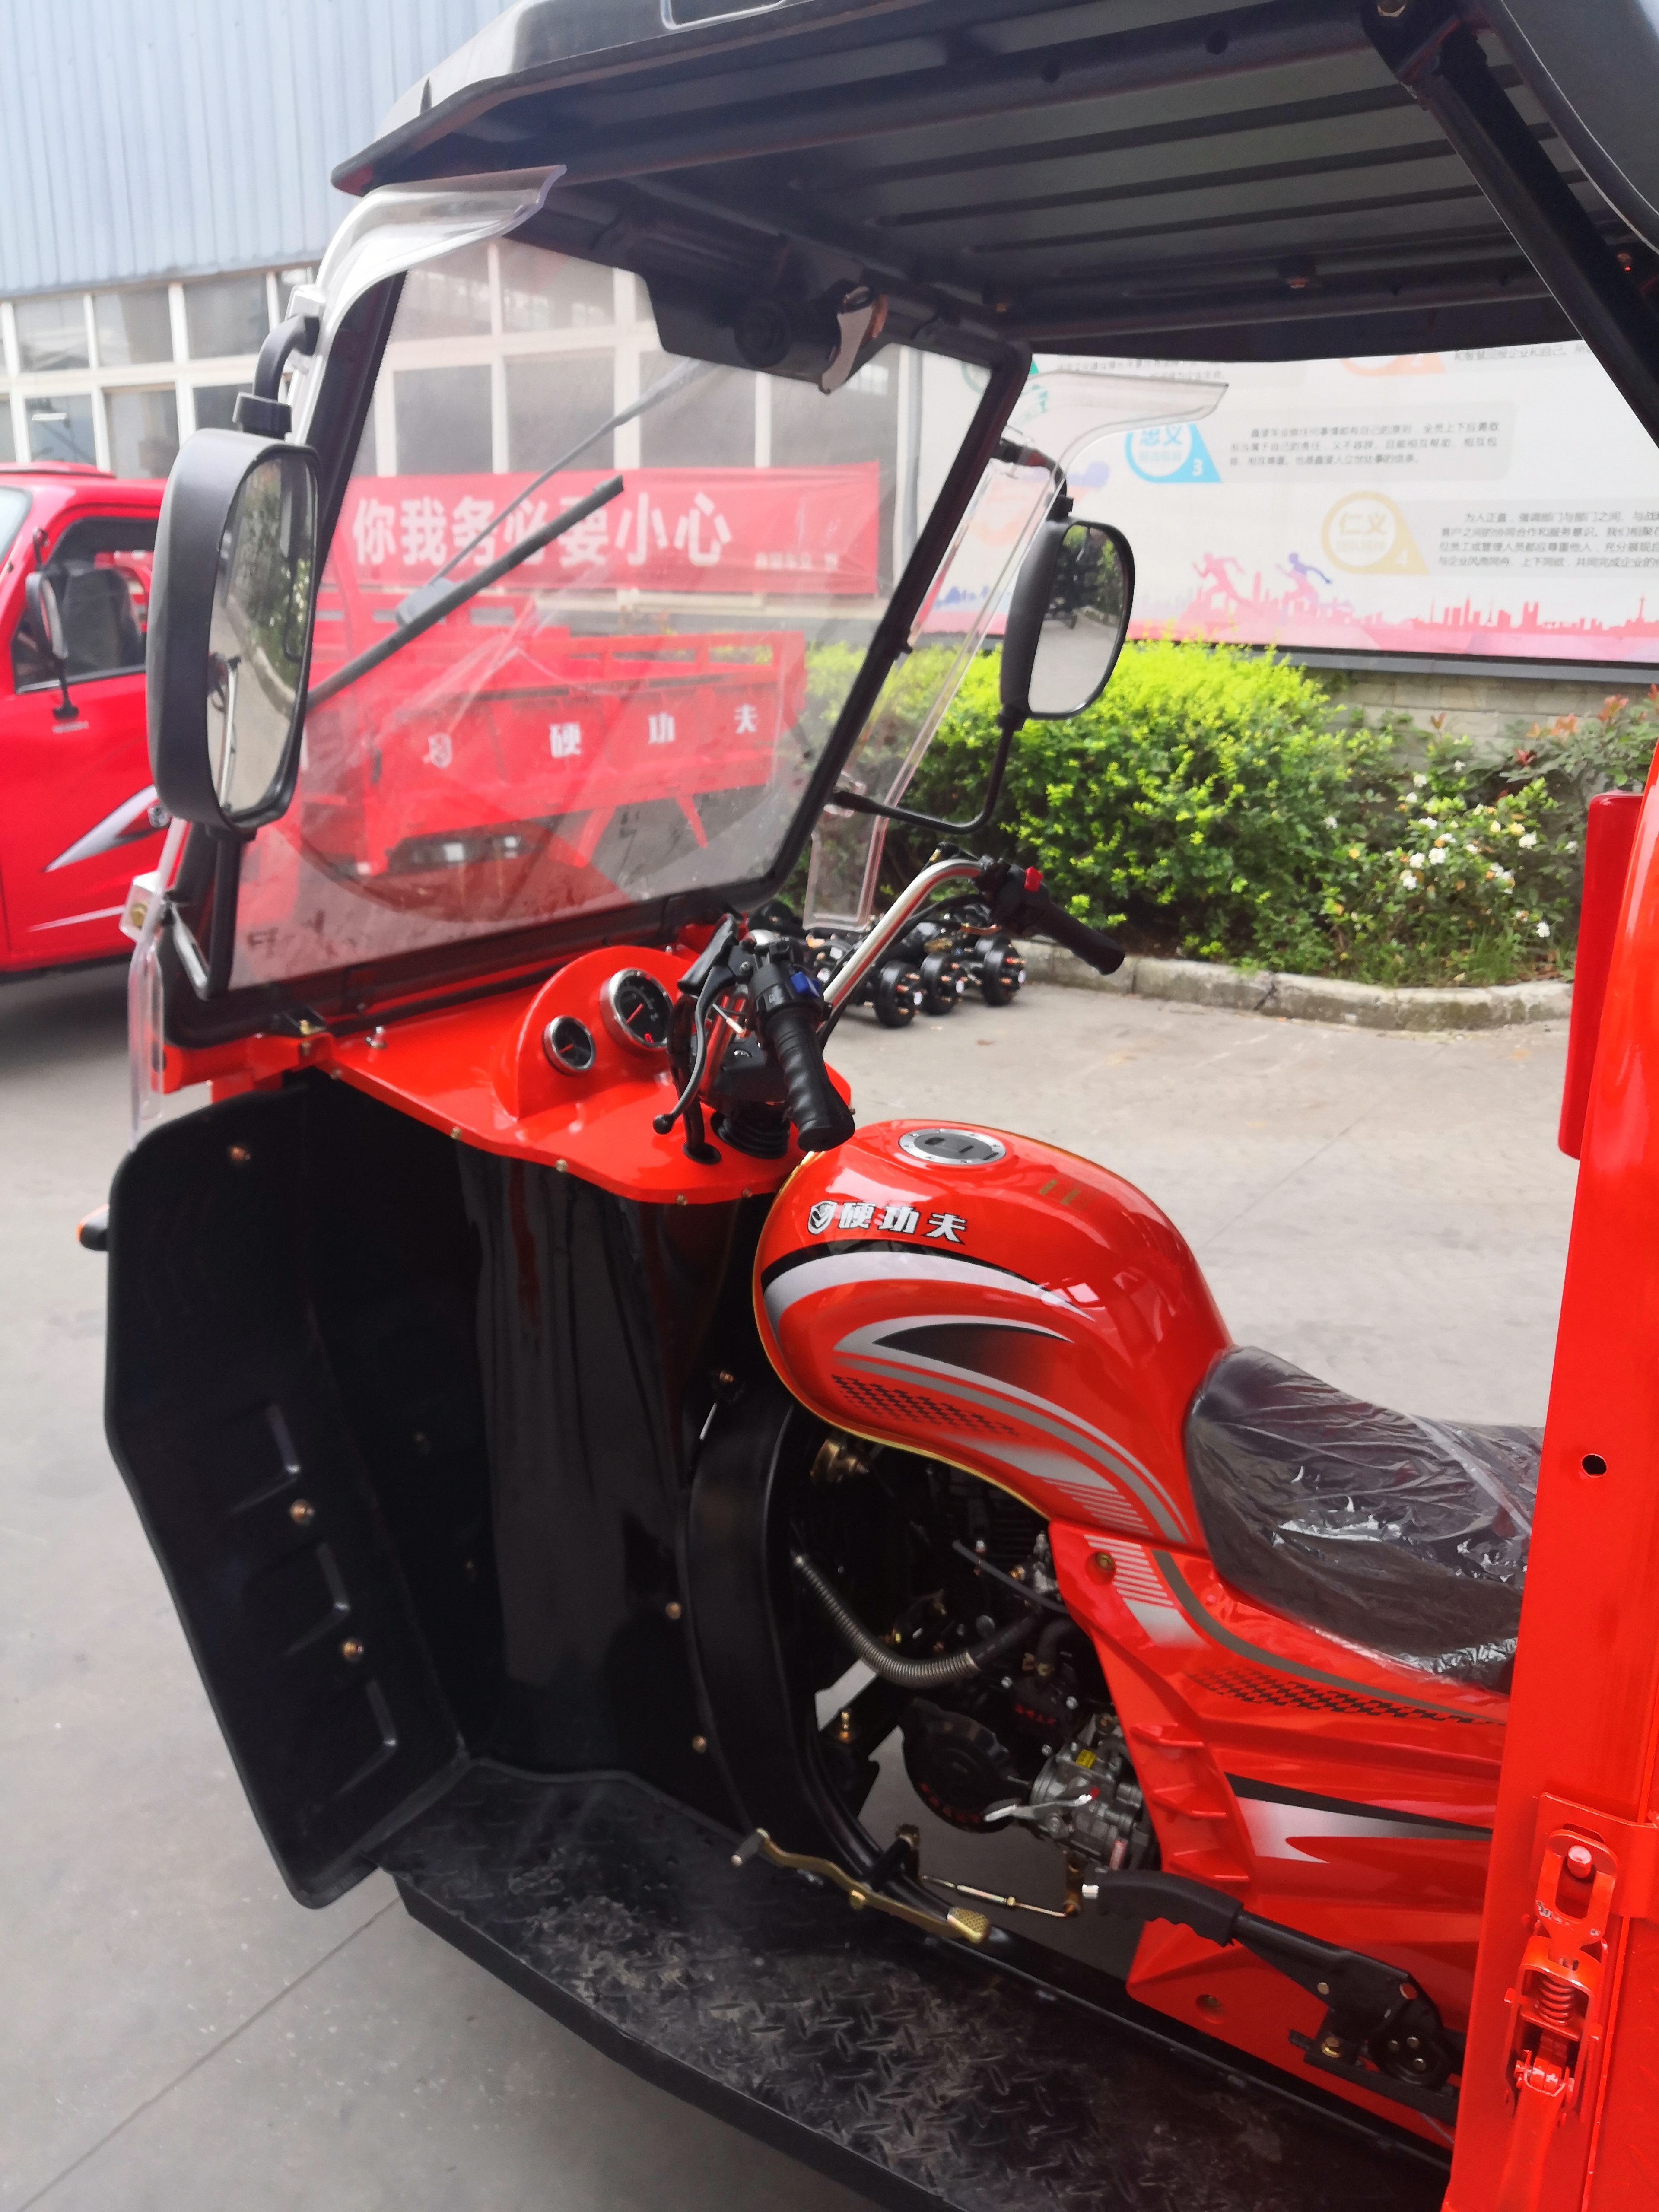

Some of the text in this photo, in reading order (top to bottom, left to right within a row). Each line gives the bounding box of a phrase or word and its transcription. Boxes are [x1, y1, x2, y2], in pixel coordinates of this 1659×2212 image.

[1192, 458, 1203, 477] 3
[352, 492, 732, 566] 你我务必要小心
[1339, 513, 1386, 535] 仁义
[1395, 549, 1408, 567] 4
[837, 1202, 967, 1244] 硬功夫
